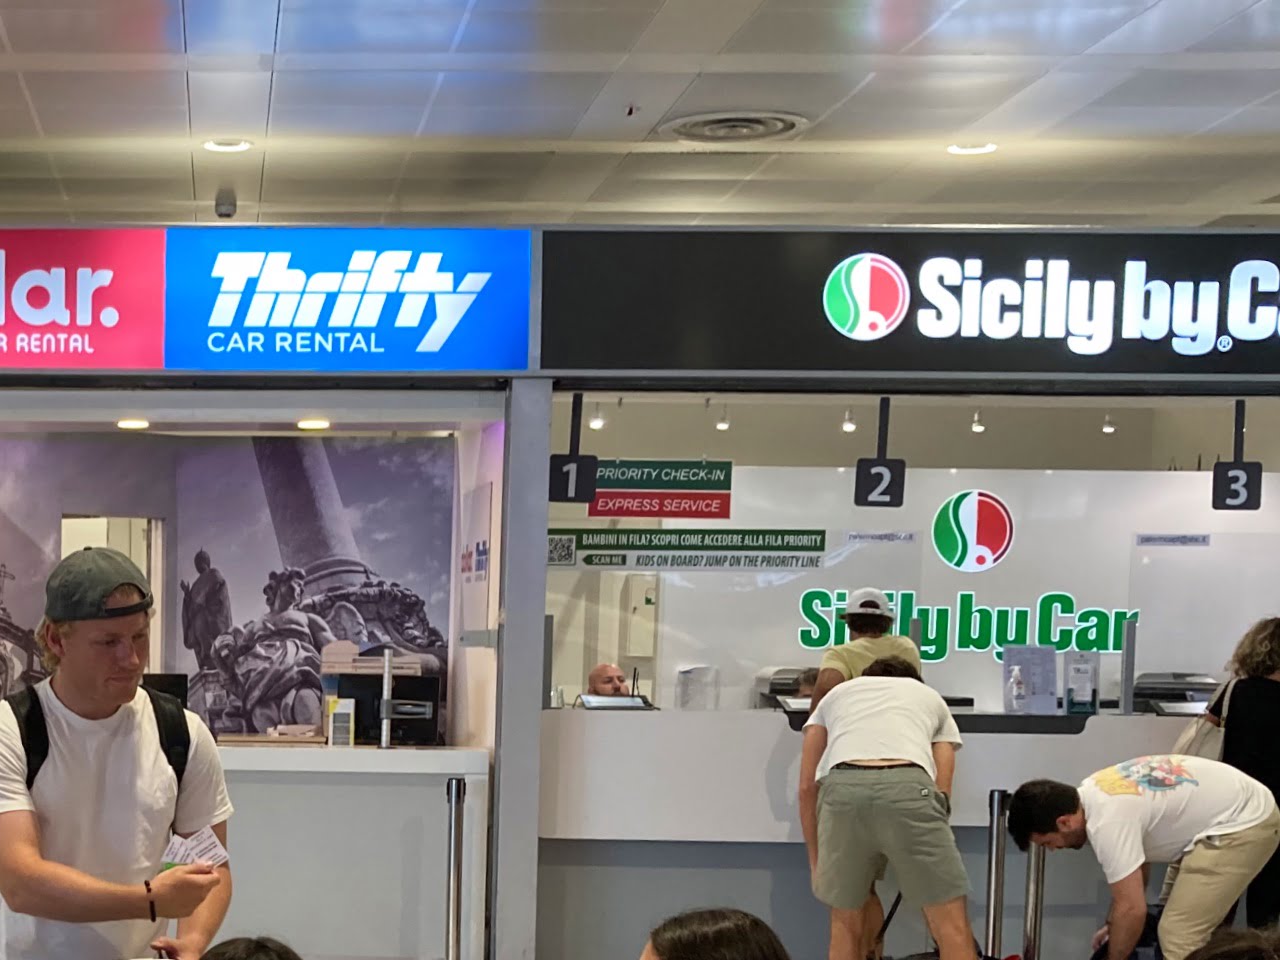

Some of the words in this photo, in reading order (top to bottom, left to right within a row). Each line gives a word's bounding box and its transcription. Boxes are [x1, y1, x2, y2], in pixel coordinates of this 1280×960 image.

[207, 250, 492, 352] Thrifty
[917, 257, 1115, 355] Sicily
[1122, 260, 1220, 356] by
[1227, 260, 1280, 341] C
[16, 333, 94, 353] RENTAL
[207, 332, 265, 352] CAR
[275, 332, 384, 352] RENTAL
[562, 463, 578, 498] 1
[596, 467, 659, 480] PRIORITY
[661, 468, 725, 481] CHECK-IN
[867, 466, 892, 502] 2
[1225, 469, 1249, 506] 3
[597, 499, 659, 511] EXPRESS
[663, 499, 720, 512] SERVICE
[582, 533, 617, 545] BAMBINI
[619, 533, 627, 545] IN
[629, 533, 649, 545] FILA?
[651, 533, 679, 545] SCOPRI
[681, 534, 702, 546] COME
[704, 534, 742, 546] ACCEDERE
[744, 534, 763, 546] ALLA
[765, 535, 782, 547] FILA
[784, 535, 822, 547] PRIORITY
[592, 555, 611, 565] SCAN
[636, 555, 656, 567] KIDS
[657, 555, 668, 567] ON
[670, 555, 703, 567] BOARD?
[704, 555, 728, 567] JUMP
[729, 555, 741, 567] ON
[743, 555, 760, 567] THE
[761, 555, 801, 567] PRIORITY
[801, 555, 821, 567] LINE
[799, 588, 951, 662] Sily
[957, 591, 1030, 662] by
